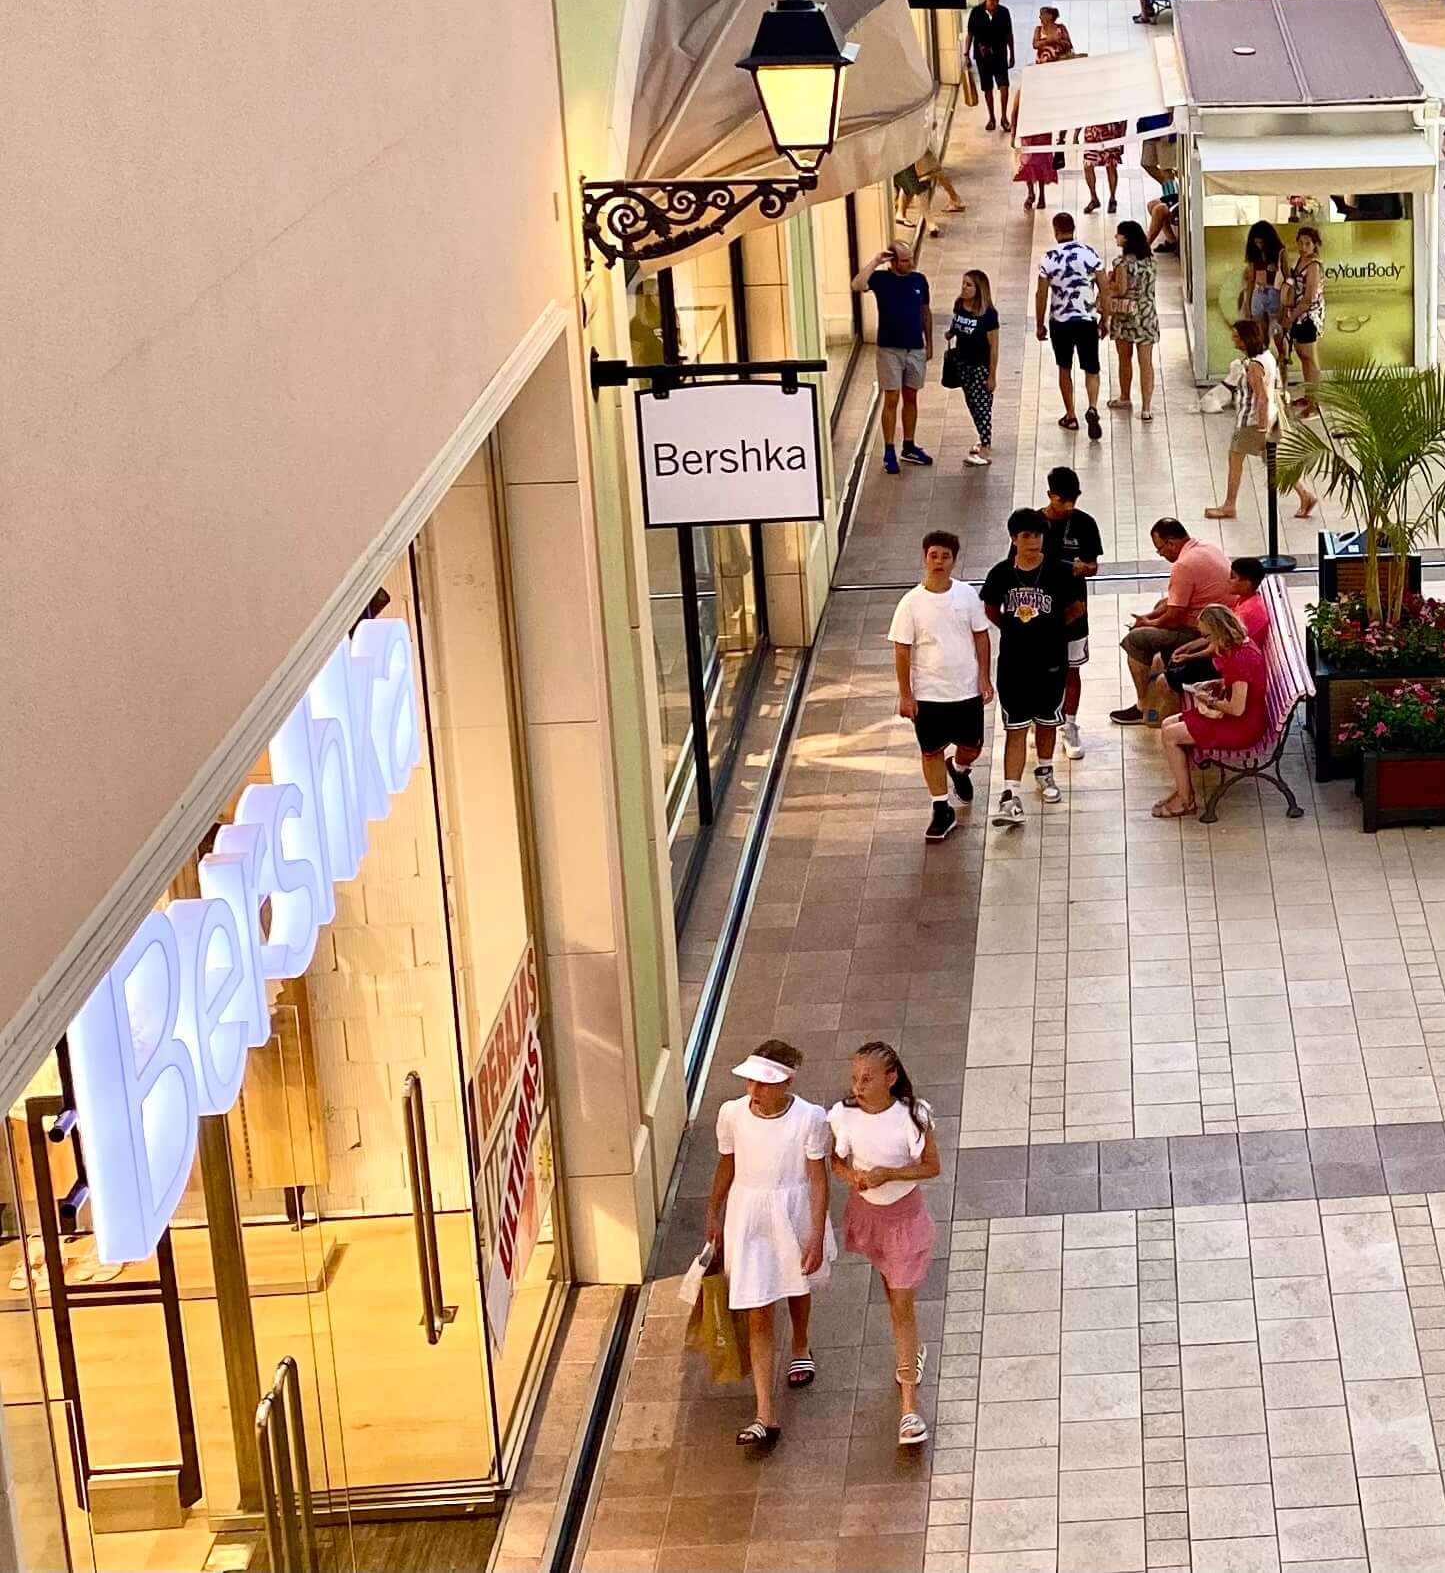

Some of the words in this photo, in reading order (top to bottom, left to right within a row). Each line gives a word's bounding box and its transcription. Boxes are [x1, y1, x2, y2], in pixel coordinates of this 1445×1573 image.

[653, 438, 807, 477] Bershka
[68, 617, 423, 1264] Bershka
[478, 947, 536, 1139] REBAJAS
